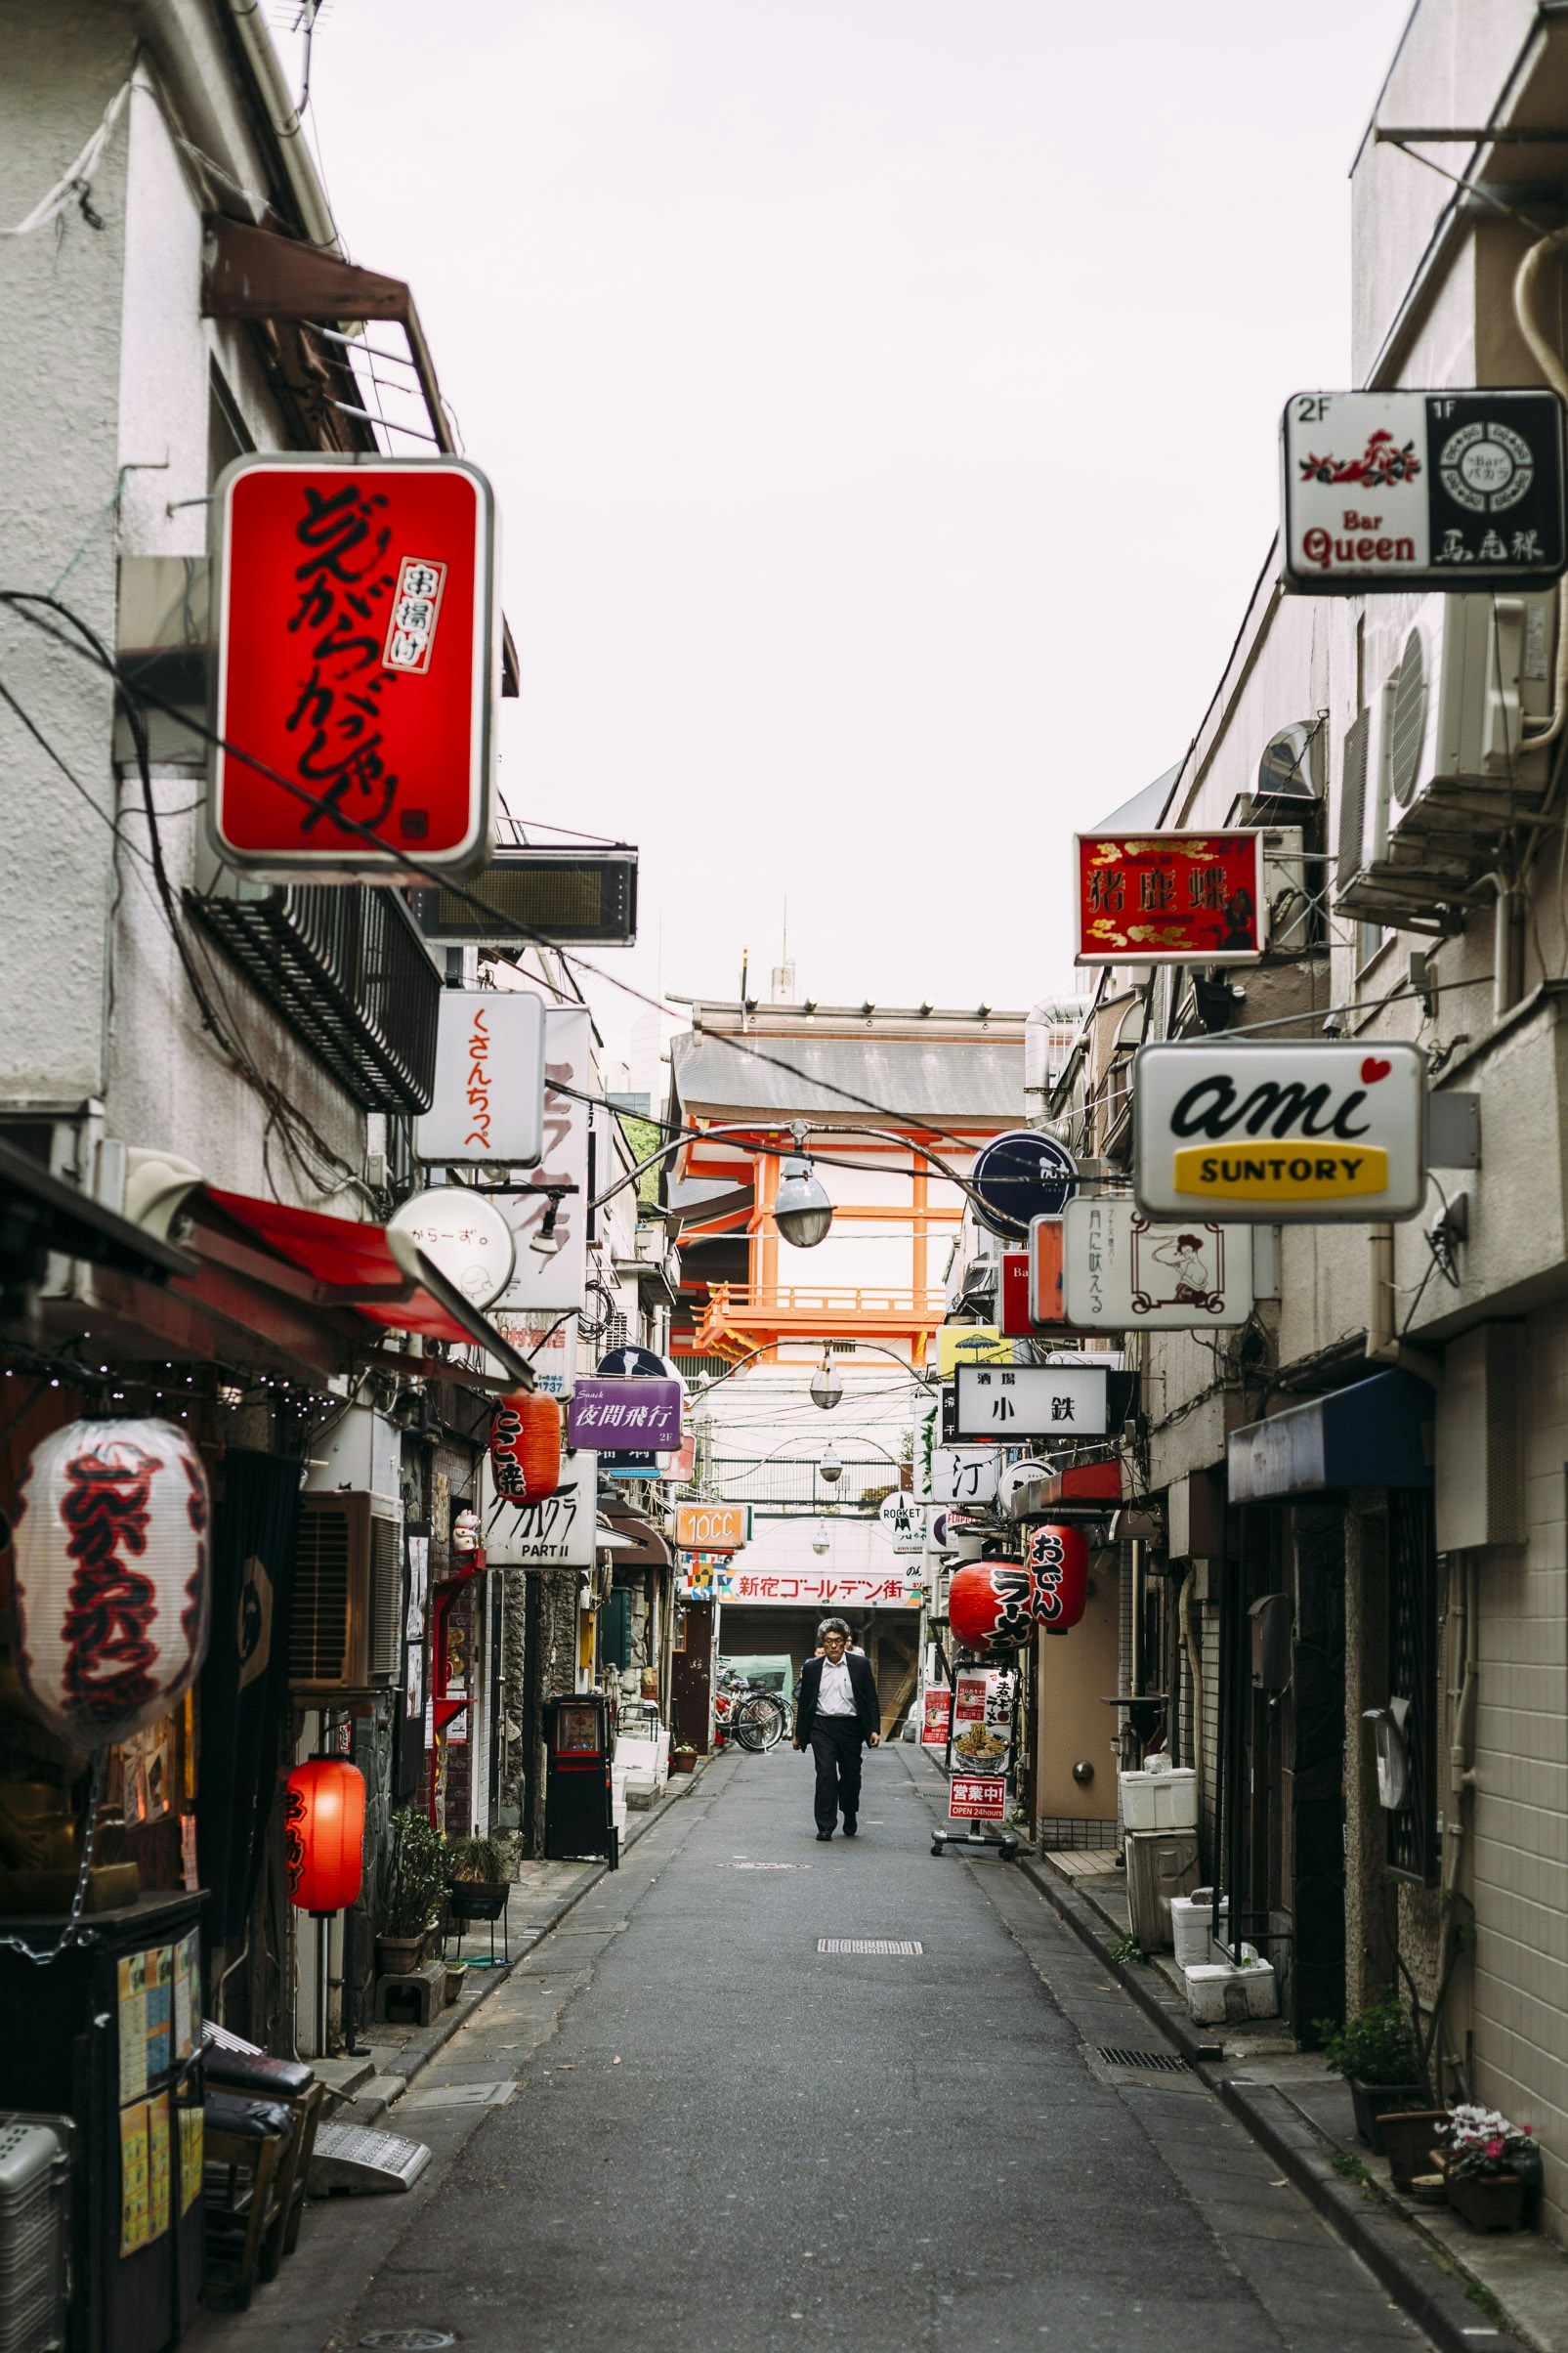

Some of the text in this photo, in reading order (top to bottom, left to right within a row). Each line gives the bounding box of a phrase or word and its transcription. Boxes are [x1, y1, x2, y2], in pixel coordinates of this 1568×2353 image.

[1298, 397, 1332, 422] 2F
[1433, 400, 1456, 419] 1F
[1342, 509, 1382, 531] Bar
[1302, 528, 1416, 569] Queen
[1086, 868, 1230, 913] 猪鹿蝶
[464, 1007, 491, 1149] くさんちっぺ
[1170, 1073, 1372, 1139] ami
[1200, 1158, 1364, 1182] SUNTORY
[1089, 1210, 1103, 1314] 月に吠える
[977, 1372, 1016, 1386] 酒場
[576, 1389, 604, 1400] Snack
[575, 1404, 674, 1428] 夜間飛行
[993, 1396, 1076, 1422] 小鉄
[659, 1433, 674, 1442] 2F
[883, 1509, 920, 1519] ROCKET
[687, 1512, 735, 1543] 10CC
[522, 1544, 558, 1558] PART
[740, 1575, 903, 1601] 新宿ゴールデン街
[1030, 1533, 1065, 1622] おでん
[954, 1782, 1003, 1804] 営業中!
[953, 1807, 1003, 1818] OPEN 24hours
